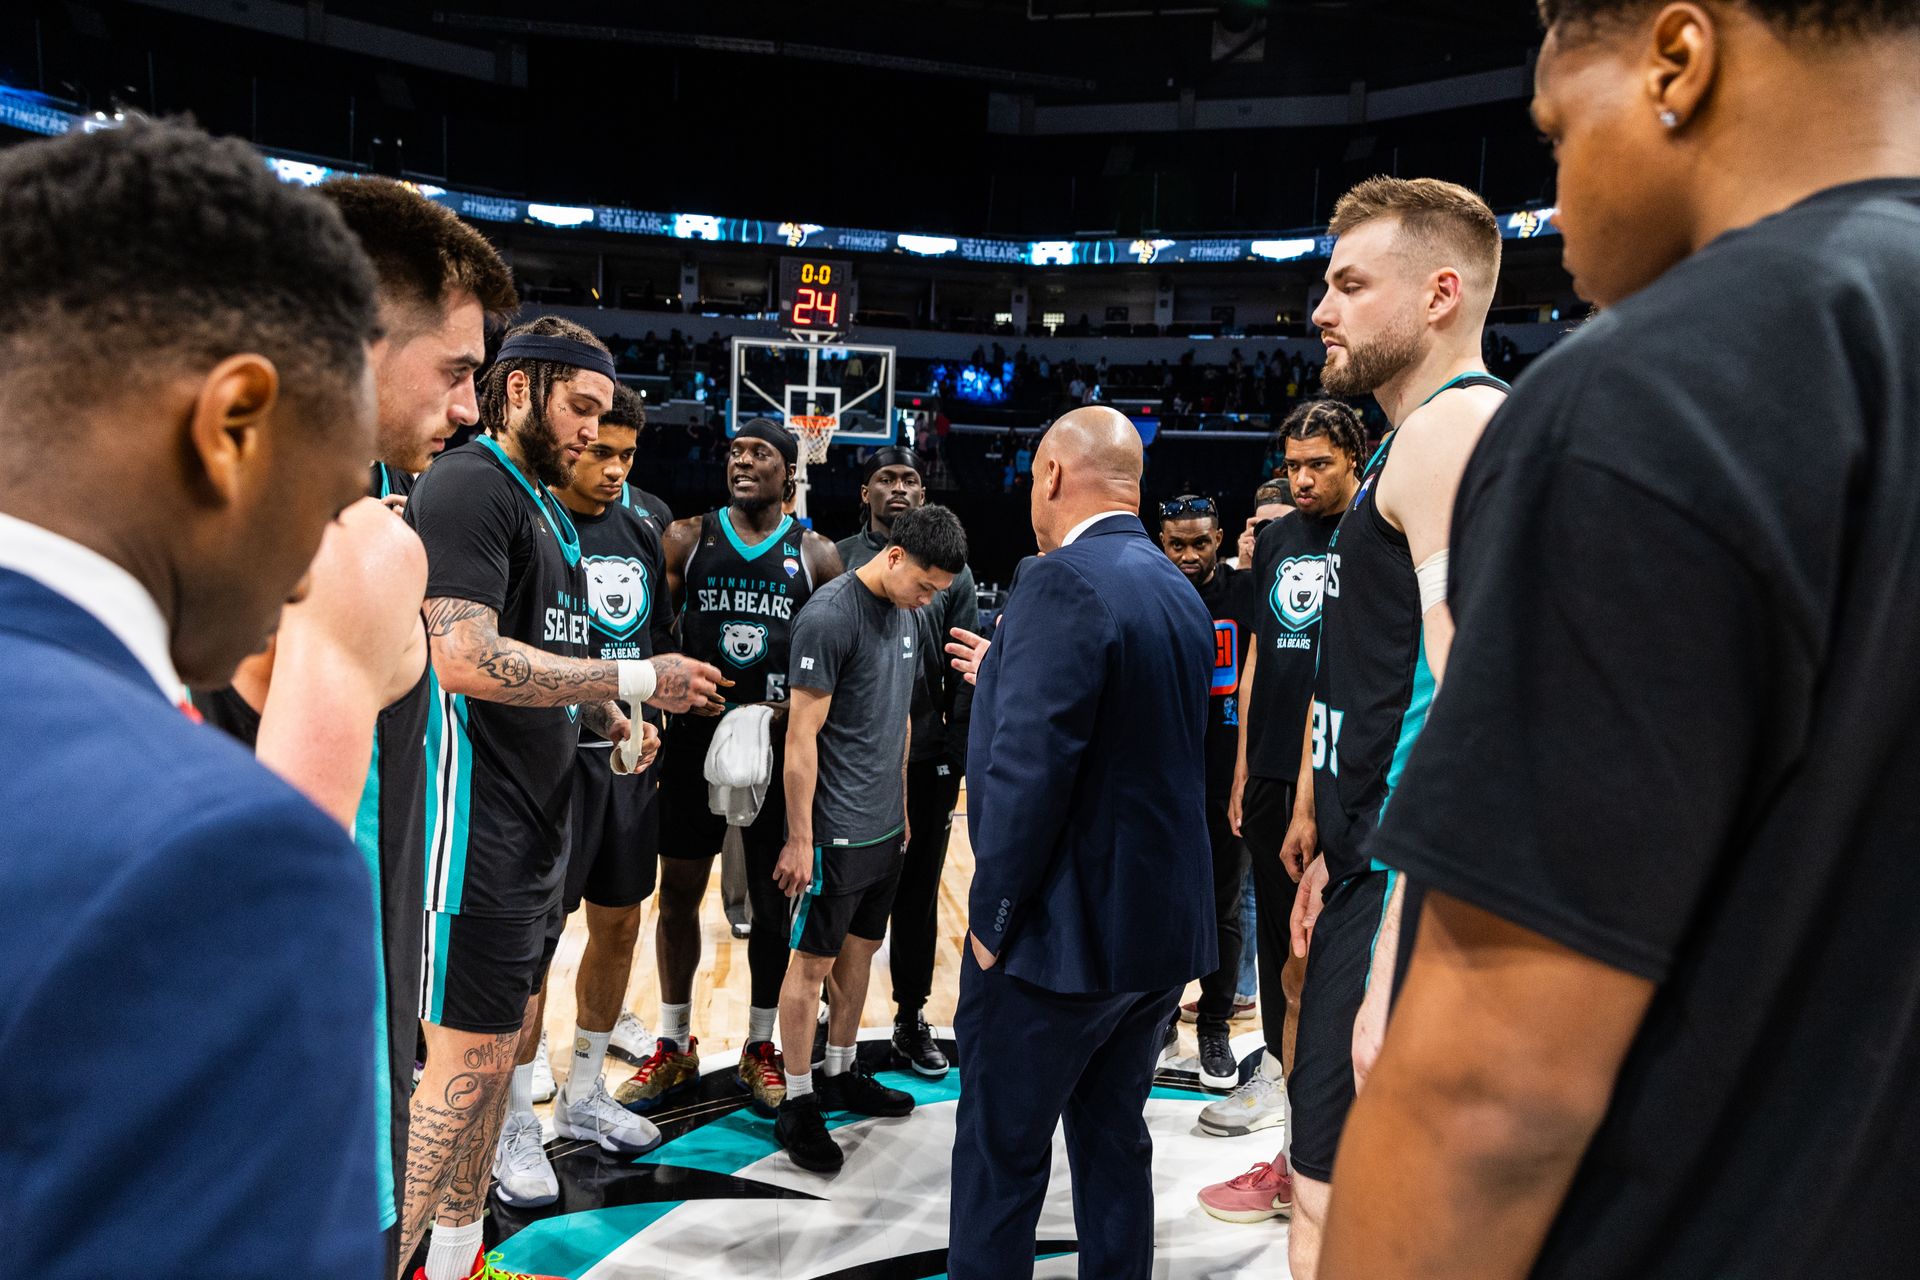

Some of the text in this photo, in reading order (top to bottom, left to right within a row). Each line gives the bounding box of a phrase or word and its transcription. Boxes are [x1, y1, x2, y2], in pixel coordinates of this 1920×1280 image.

[599, 213, 662, 231] SEA BEARS
[962, 244, 1019, 260] SEA BEARS
[801, 263, 831, 285] 0.0
[793, 288, 837, 325] 24
[707, 576, 787, 594] WINNIPEG
[697, 589, 794, 620] SEA BEARS
[1276, 638, 1311, 650] SEA BEARS
[601, 647, 640, 660] SEA BEARS
